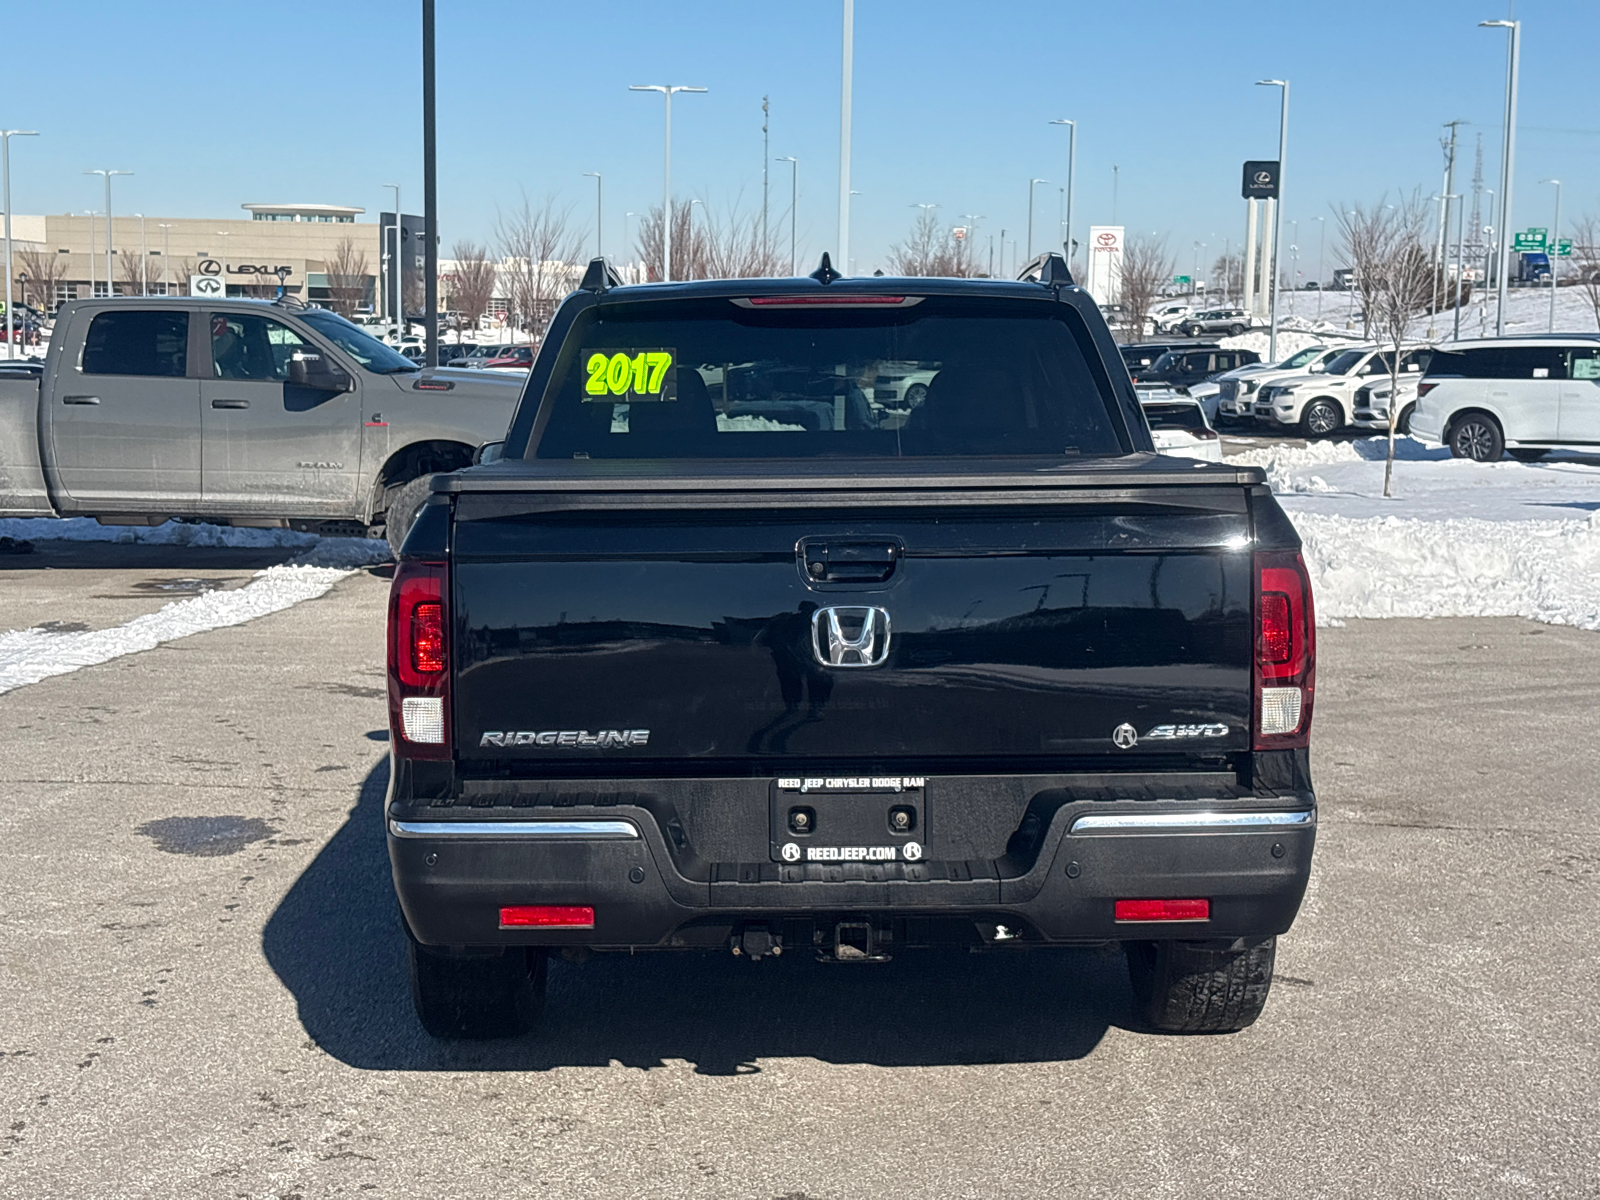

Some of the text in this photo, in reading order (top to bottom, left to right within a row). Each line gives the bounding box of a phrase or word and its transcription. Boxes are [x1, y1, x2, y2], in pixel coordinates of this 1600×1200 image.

[226, 264, 293, 276] LEXUS
[585, 352, 673, 396] 2017
[297, 461, 344, 469] RAM
[479, 729, 651, 748] RIDGELINE
[778, 777, 925, 788] REED JEEP CHRYSLER DODGE RAM
[807, 847, 896, 860] REEDJEEP.COM
